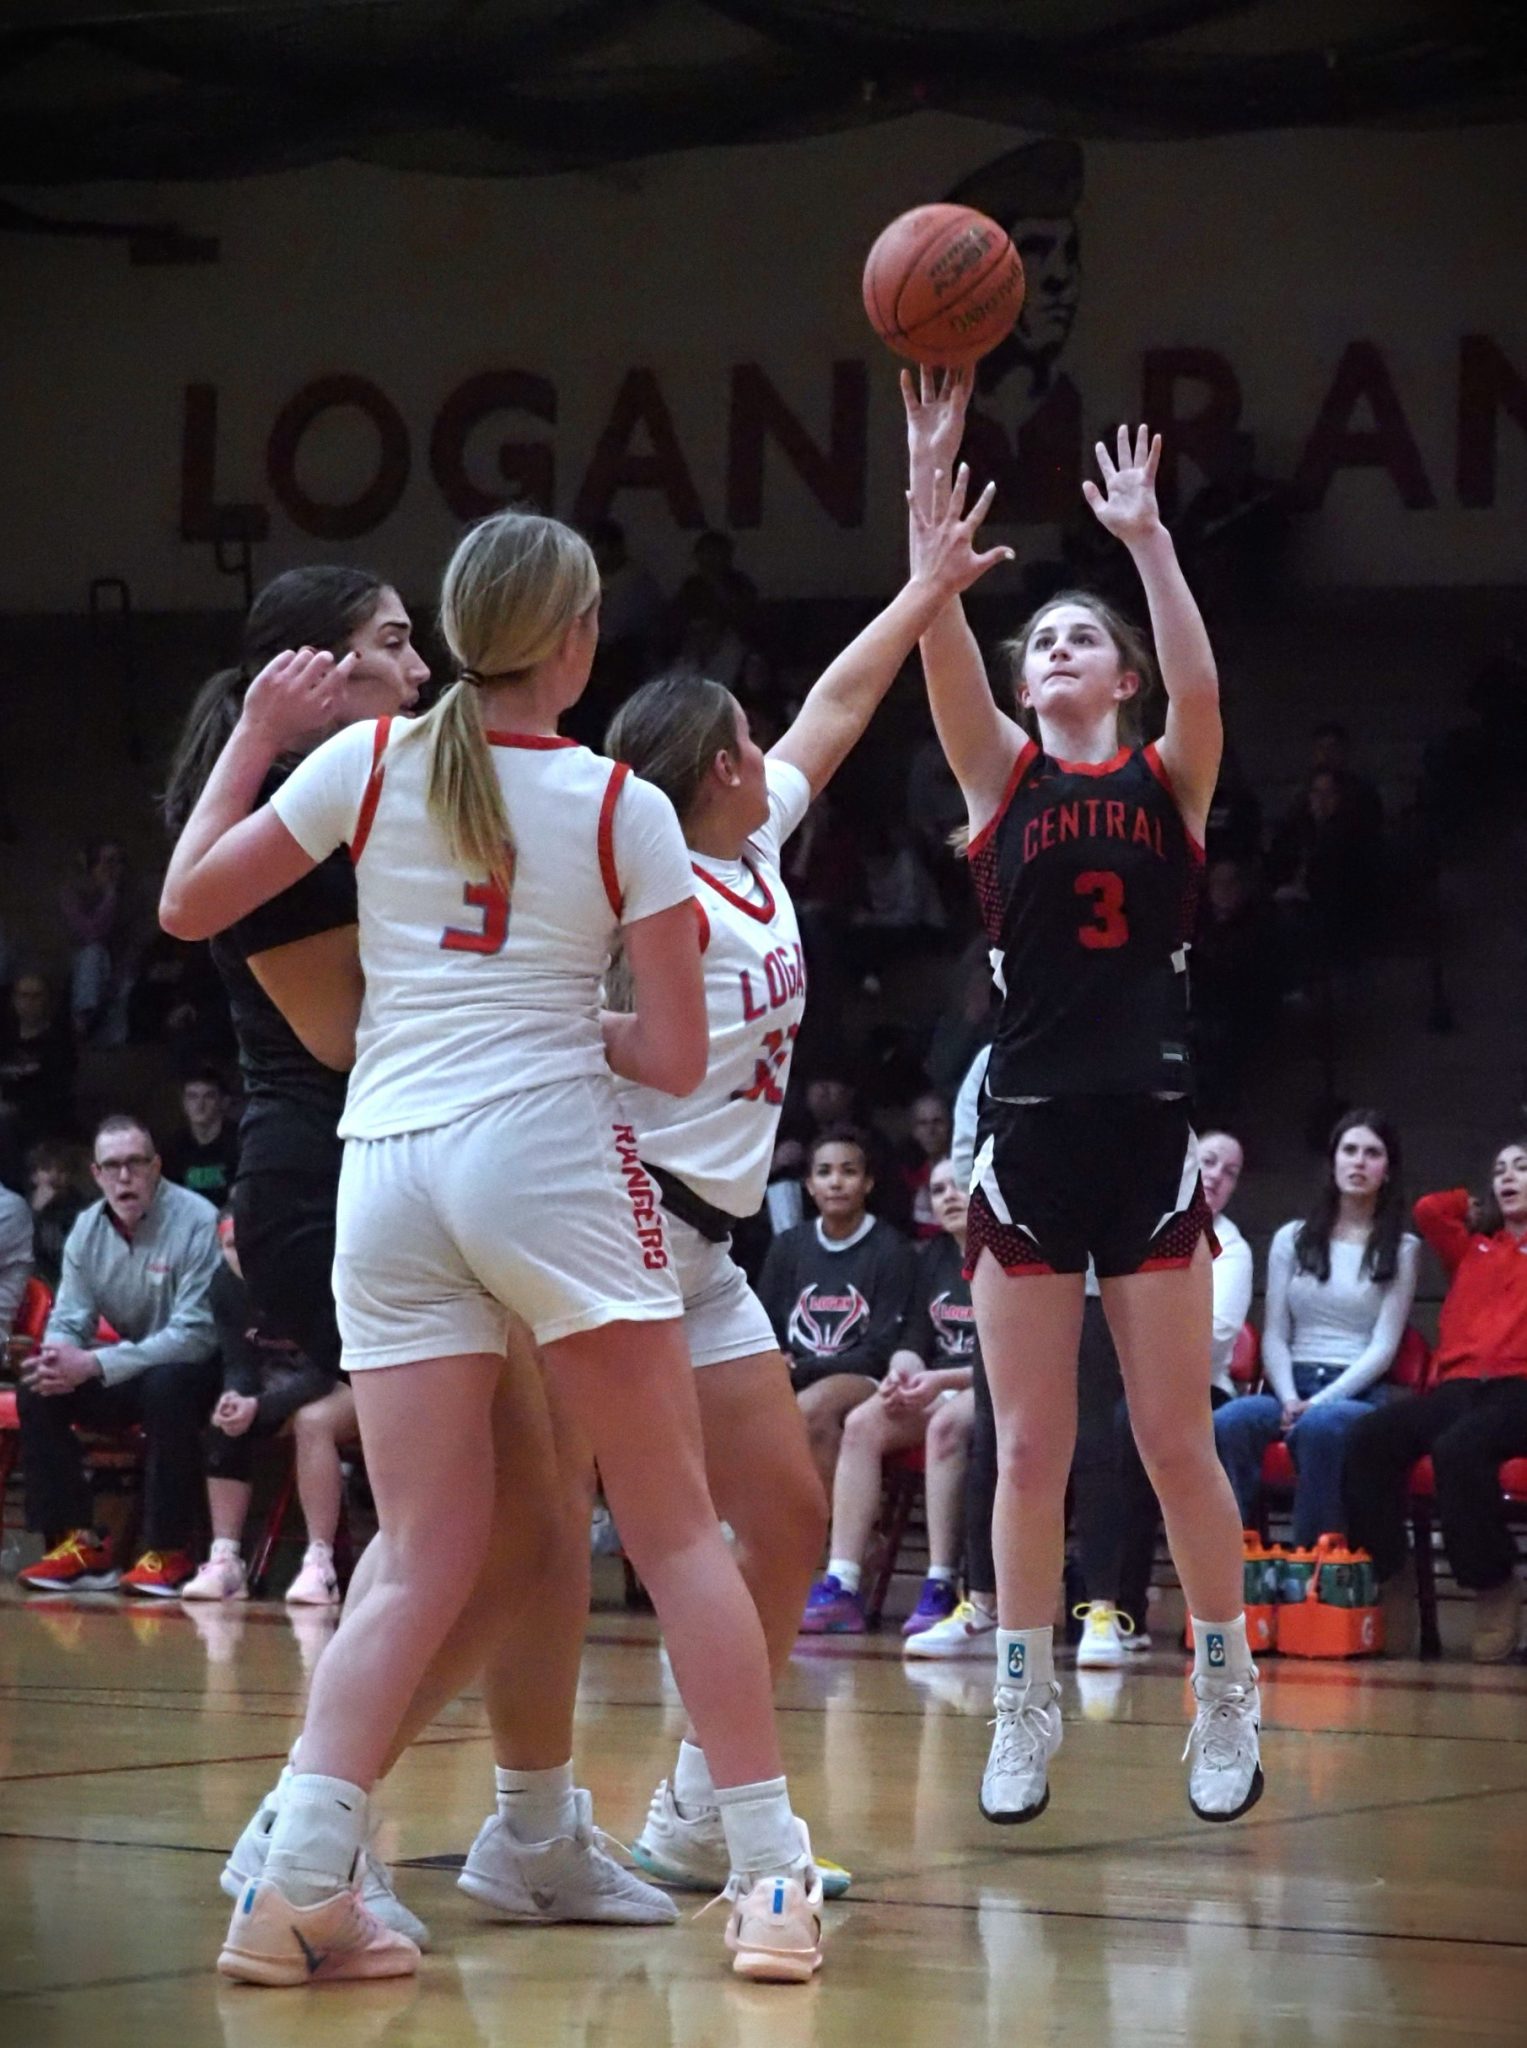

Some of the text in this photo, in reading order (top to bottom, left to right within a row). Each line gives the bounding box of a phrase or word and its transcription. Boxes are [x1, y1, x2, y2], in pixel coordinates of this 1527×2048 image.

[180, 359, 868, 542] LOGAN
[1023, 800, 1167, 864] CENTRAL
[1073, 869, 1131, 951] 3
[612, 1123, 668, 1270] RANGERS
